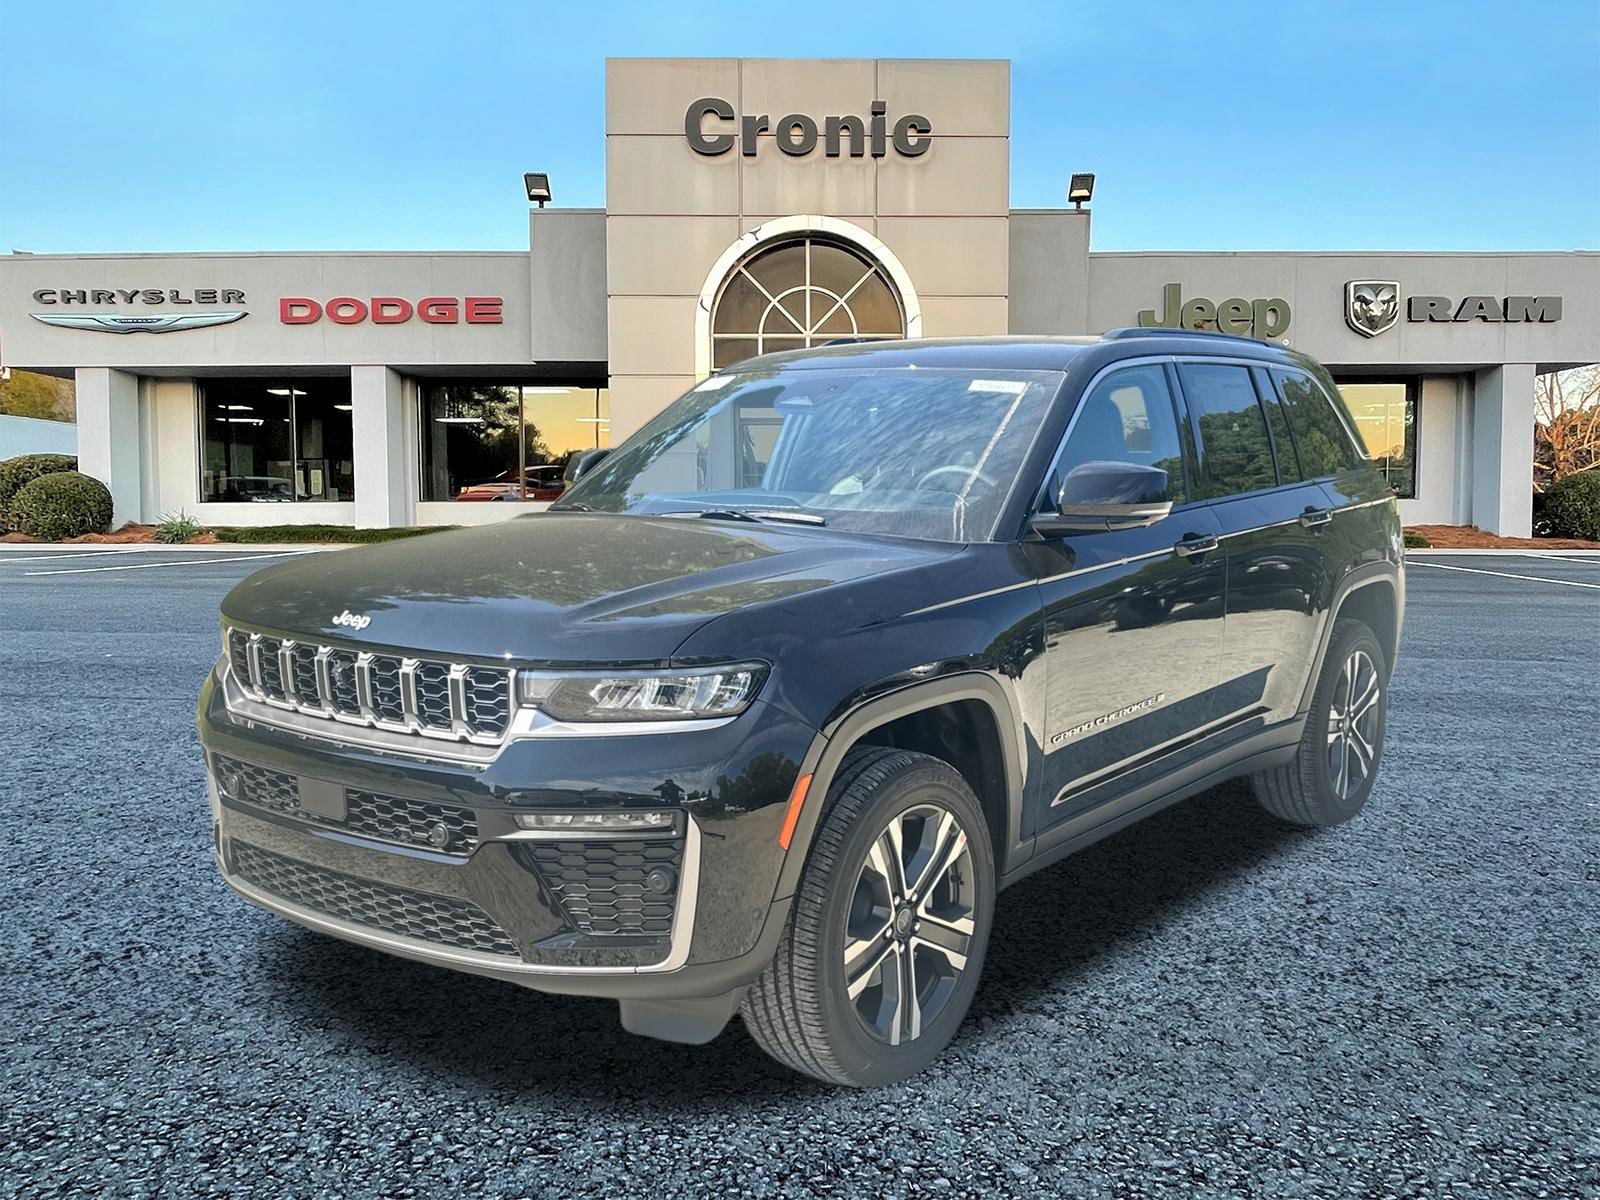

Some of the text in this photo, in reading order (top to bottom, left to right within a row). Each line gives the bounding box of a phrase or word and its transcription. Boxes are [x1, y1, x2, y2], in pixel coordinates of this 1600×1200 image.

[685, 97, 932, 157] Cronic
[32, 289, 246, 304] CHRYSLER
[1407, 296, 1562, 322] RAM
[280, 297, 503, 324] DODGE
[1138, 283, 1291, 340] Jeep
[332, 610, 371, 630] Jeep
[1051, 696, 1156, 744] GRAND CHEROKEE
